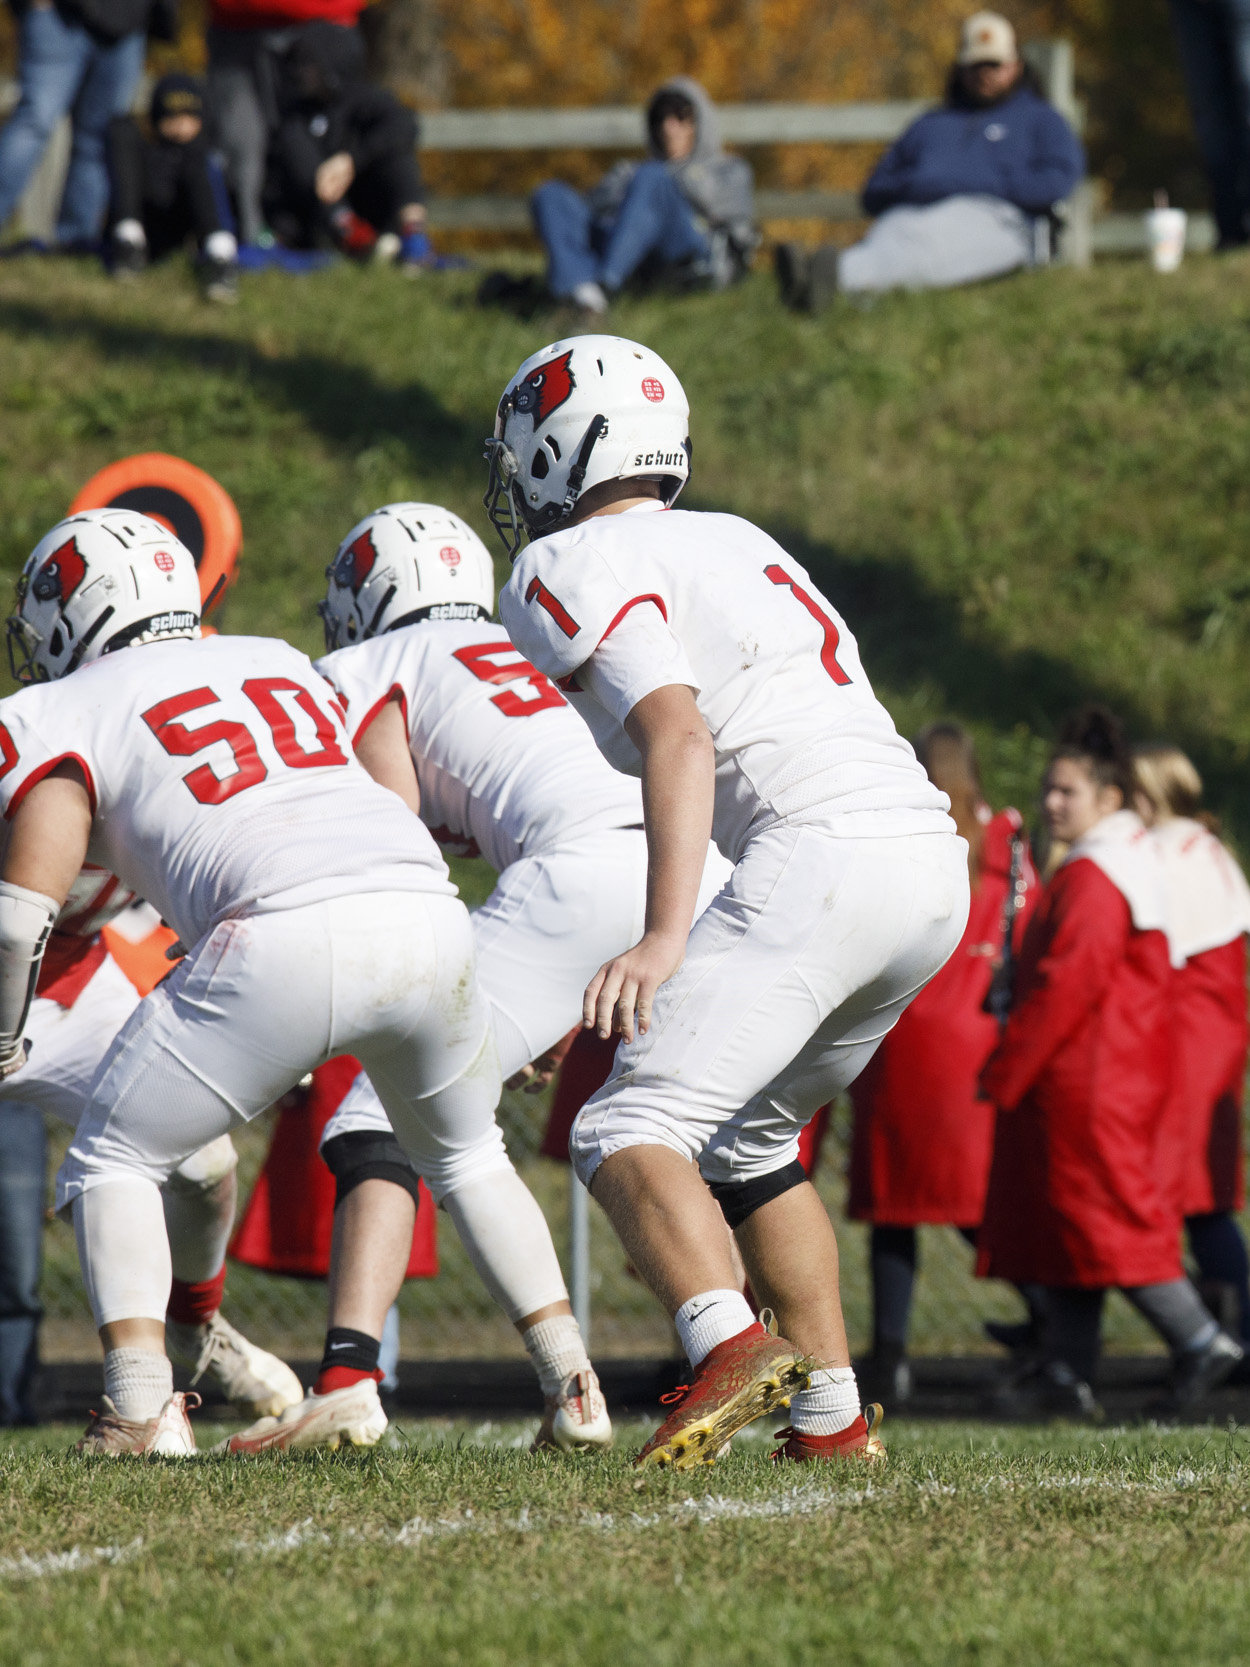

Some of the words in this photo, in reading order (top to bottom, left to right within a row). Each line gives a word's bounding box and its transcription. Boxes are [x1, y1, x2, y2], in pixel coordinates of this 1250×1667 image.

[634, 450, 684, 467] schutt
[150, 611, 194, 632] schutt
[429, 602, 479, 619] schutt
[525, 575, 581, 640] 1
[763, 564, 853, 686] 1
[141, 677, 349, 806] 50
